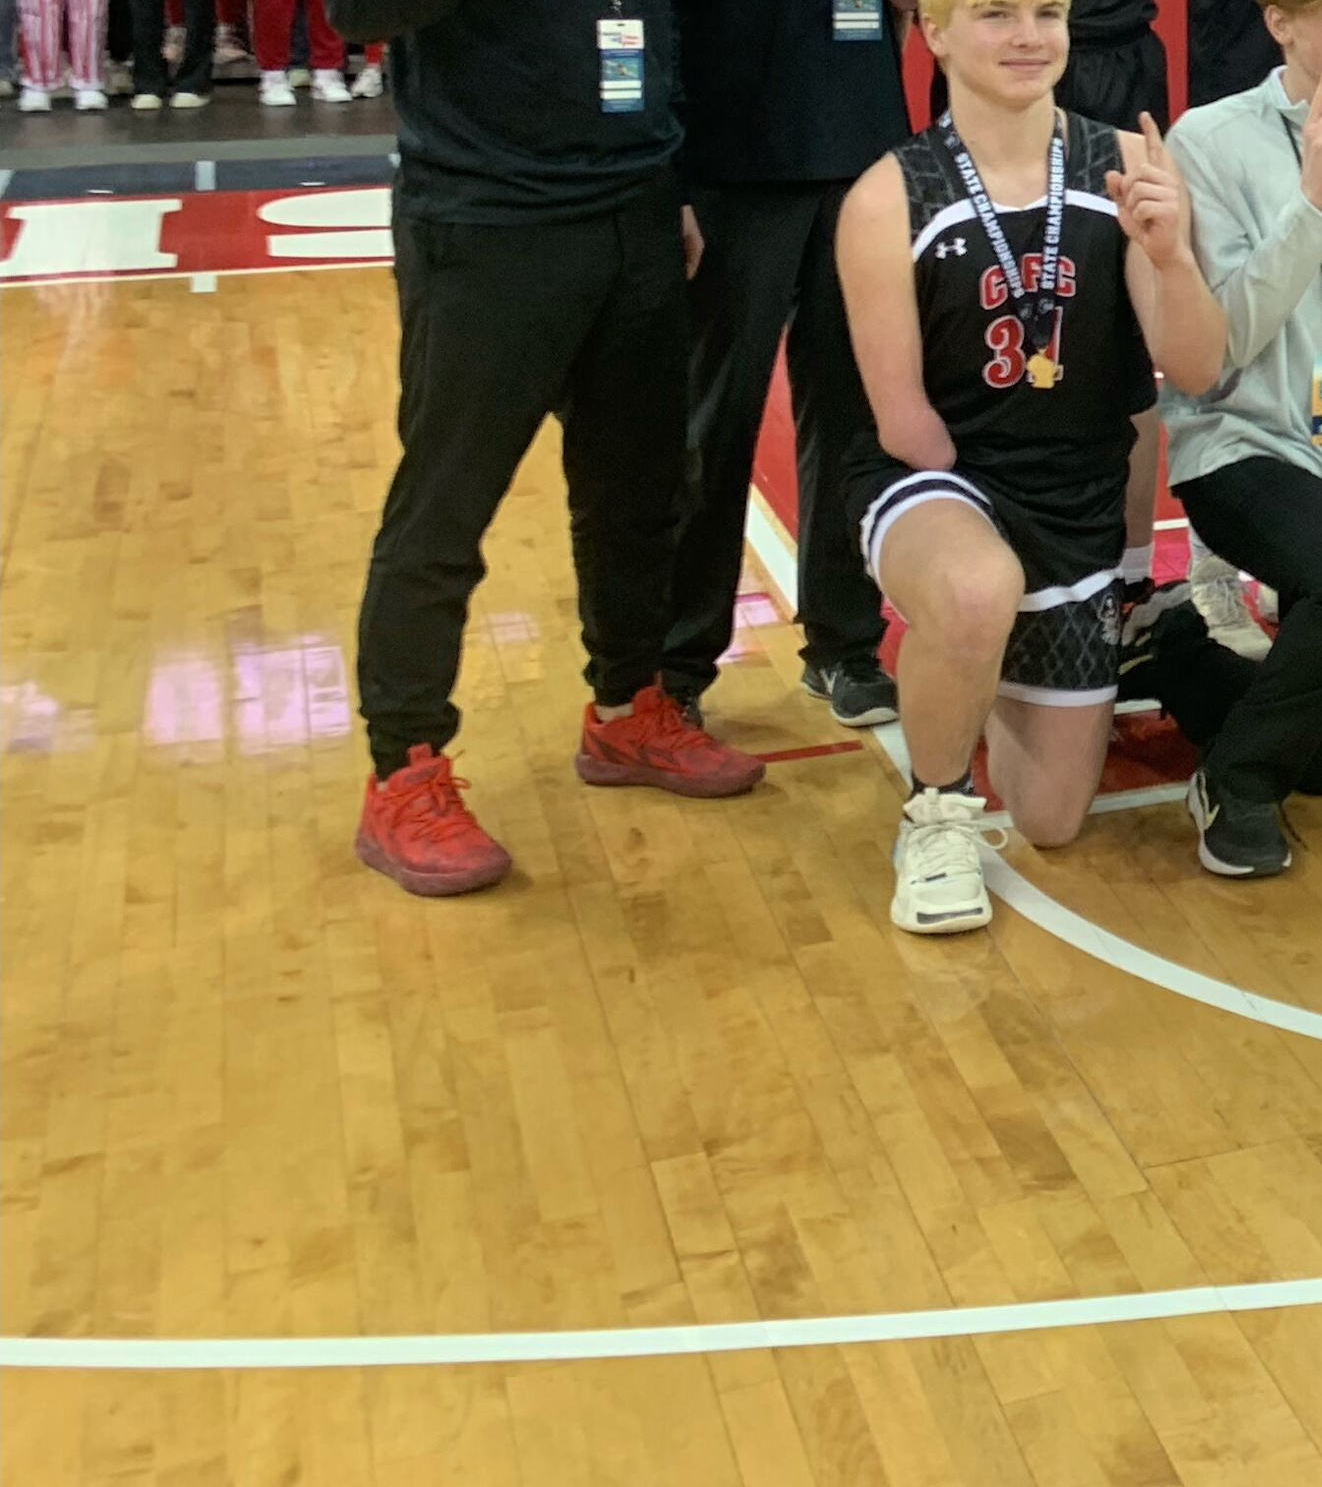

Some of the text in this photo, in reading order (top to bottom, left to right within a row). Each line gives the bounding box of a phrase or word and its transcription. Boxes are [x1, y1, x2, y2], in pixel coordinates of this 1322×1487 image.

[954, 152, 1025, 299] STATE CHAMPIONSHIPS
[1040, 137, 1065, 290] STATE CHAMPIONSHIPS
